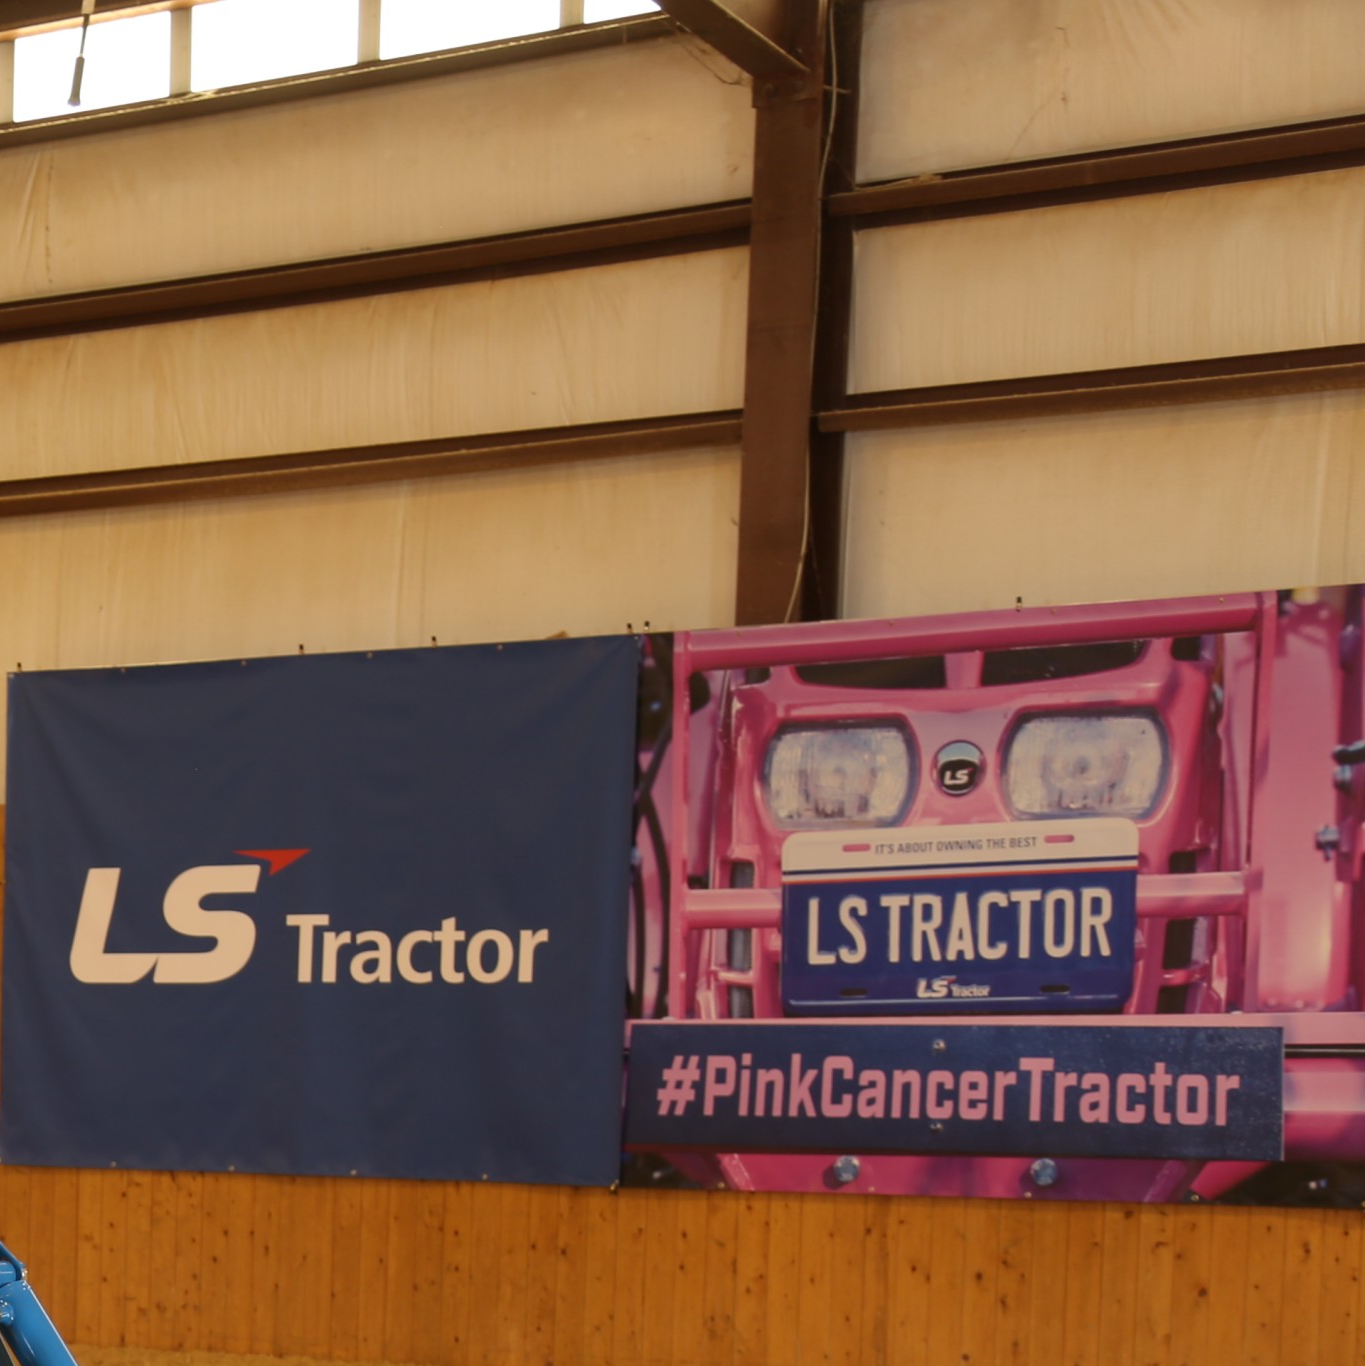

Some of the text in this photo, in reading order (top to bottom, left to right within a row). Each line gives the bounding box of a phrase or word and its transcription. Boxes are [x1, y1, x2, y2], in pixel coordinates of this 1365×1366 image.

[943, 769, 970, 786] LS
[875, 836, 1037, 854] IT'S ABOUT OWNING THE BEST
[70, 864, 549, 985] LS Tractor
[807, 886, 1113, 965] LS TRACTOR
[916, 977, 991, 998] LS Tractor
[657, 1053, 1241, 1126] #PinkCancerTractor
